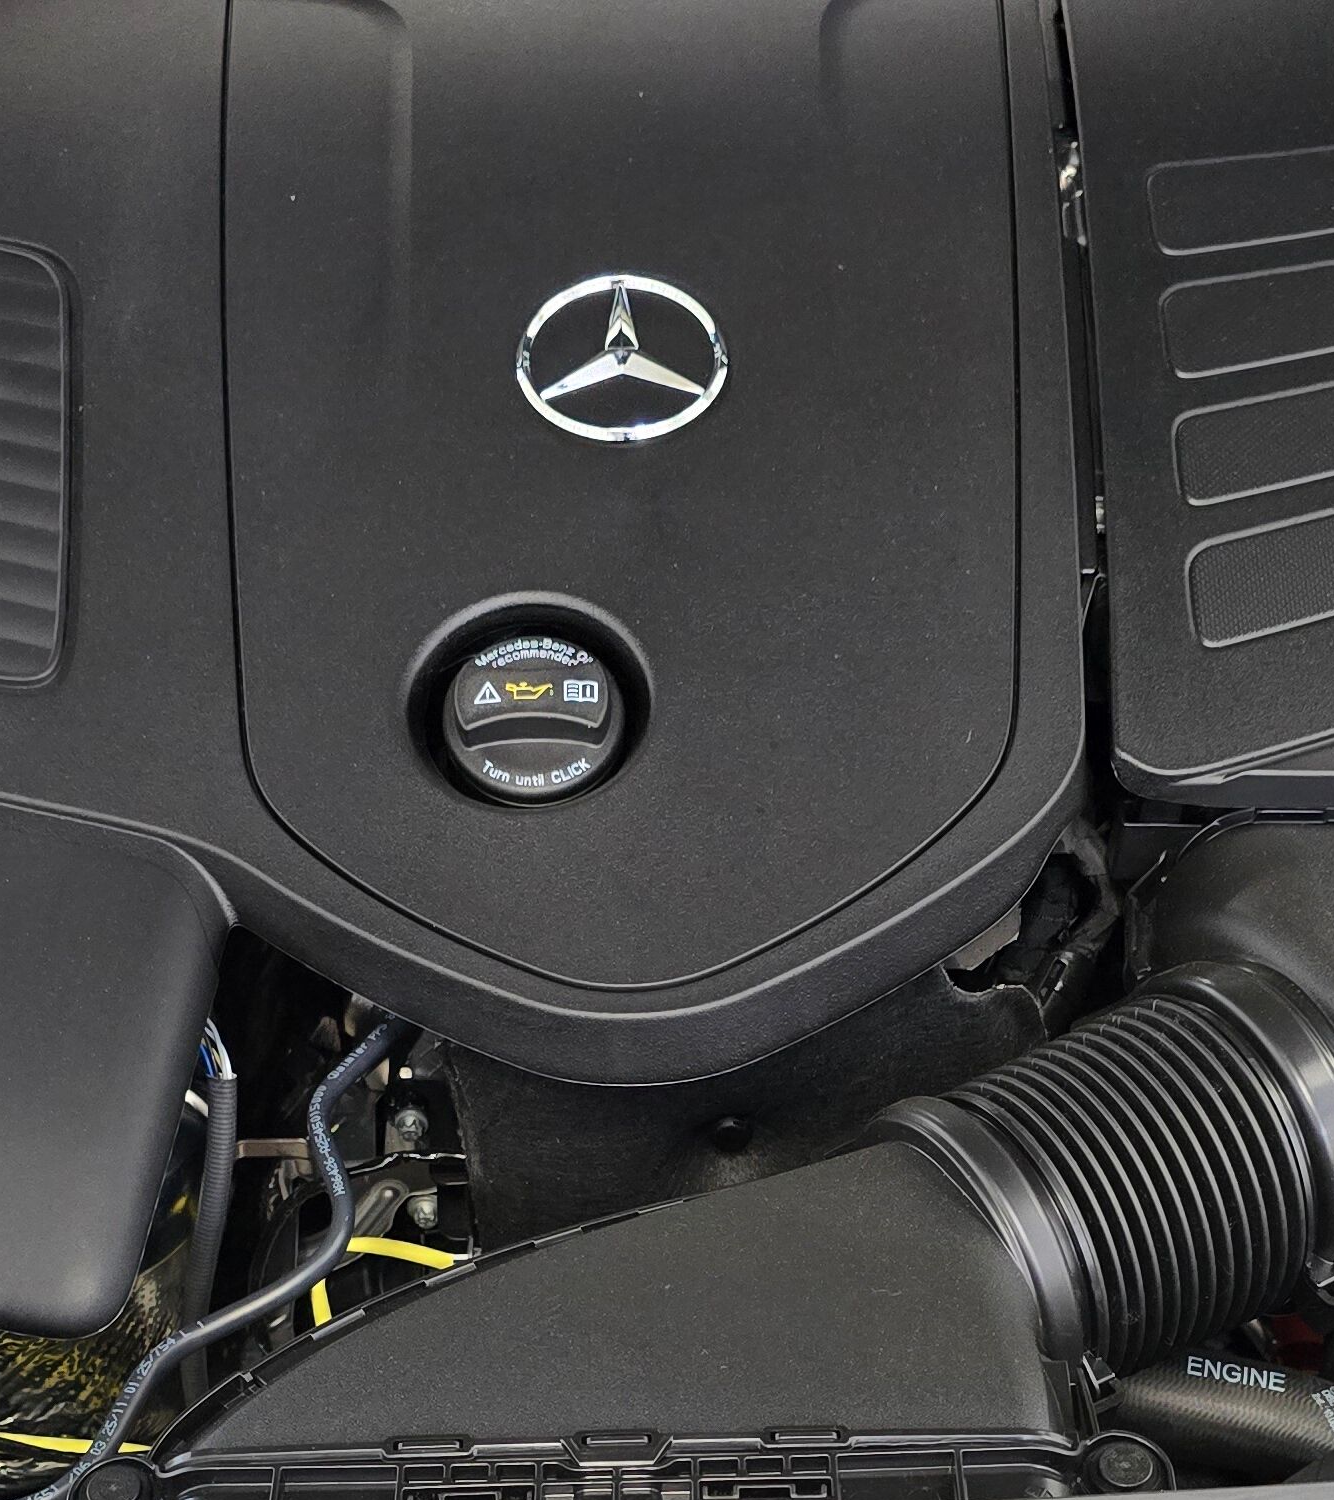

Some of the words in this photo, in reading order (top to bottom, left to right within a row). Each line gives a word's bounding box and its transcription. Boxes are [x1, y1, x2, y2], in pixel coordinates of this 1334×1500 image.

[474, 637, 576, 667] Mercedes-Benz
[482, 759, 510, 783] Turn
[515, 773, 545, 787] until
[551, 757, 592, 784] CLICK
[1187, 1355, 1287, 1393] ENGINE
